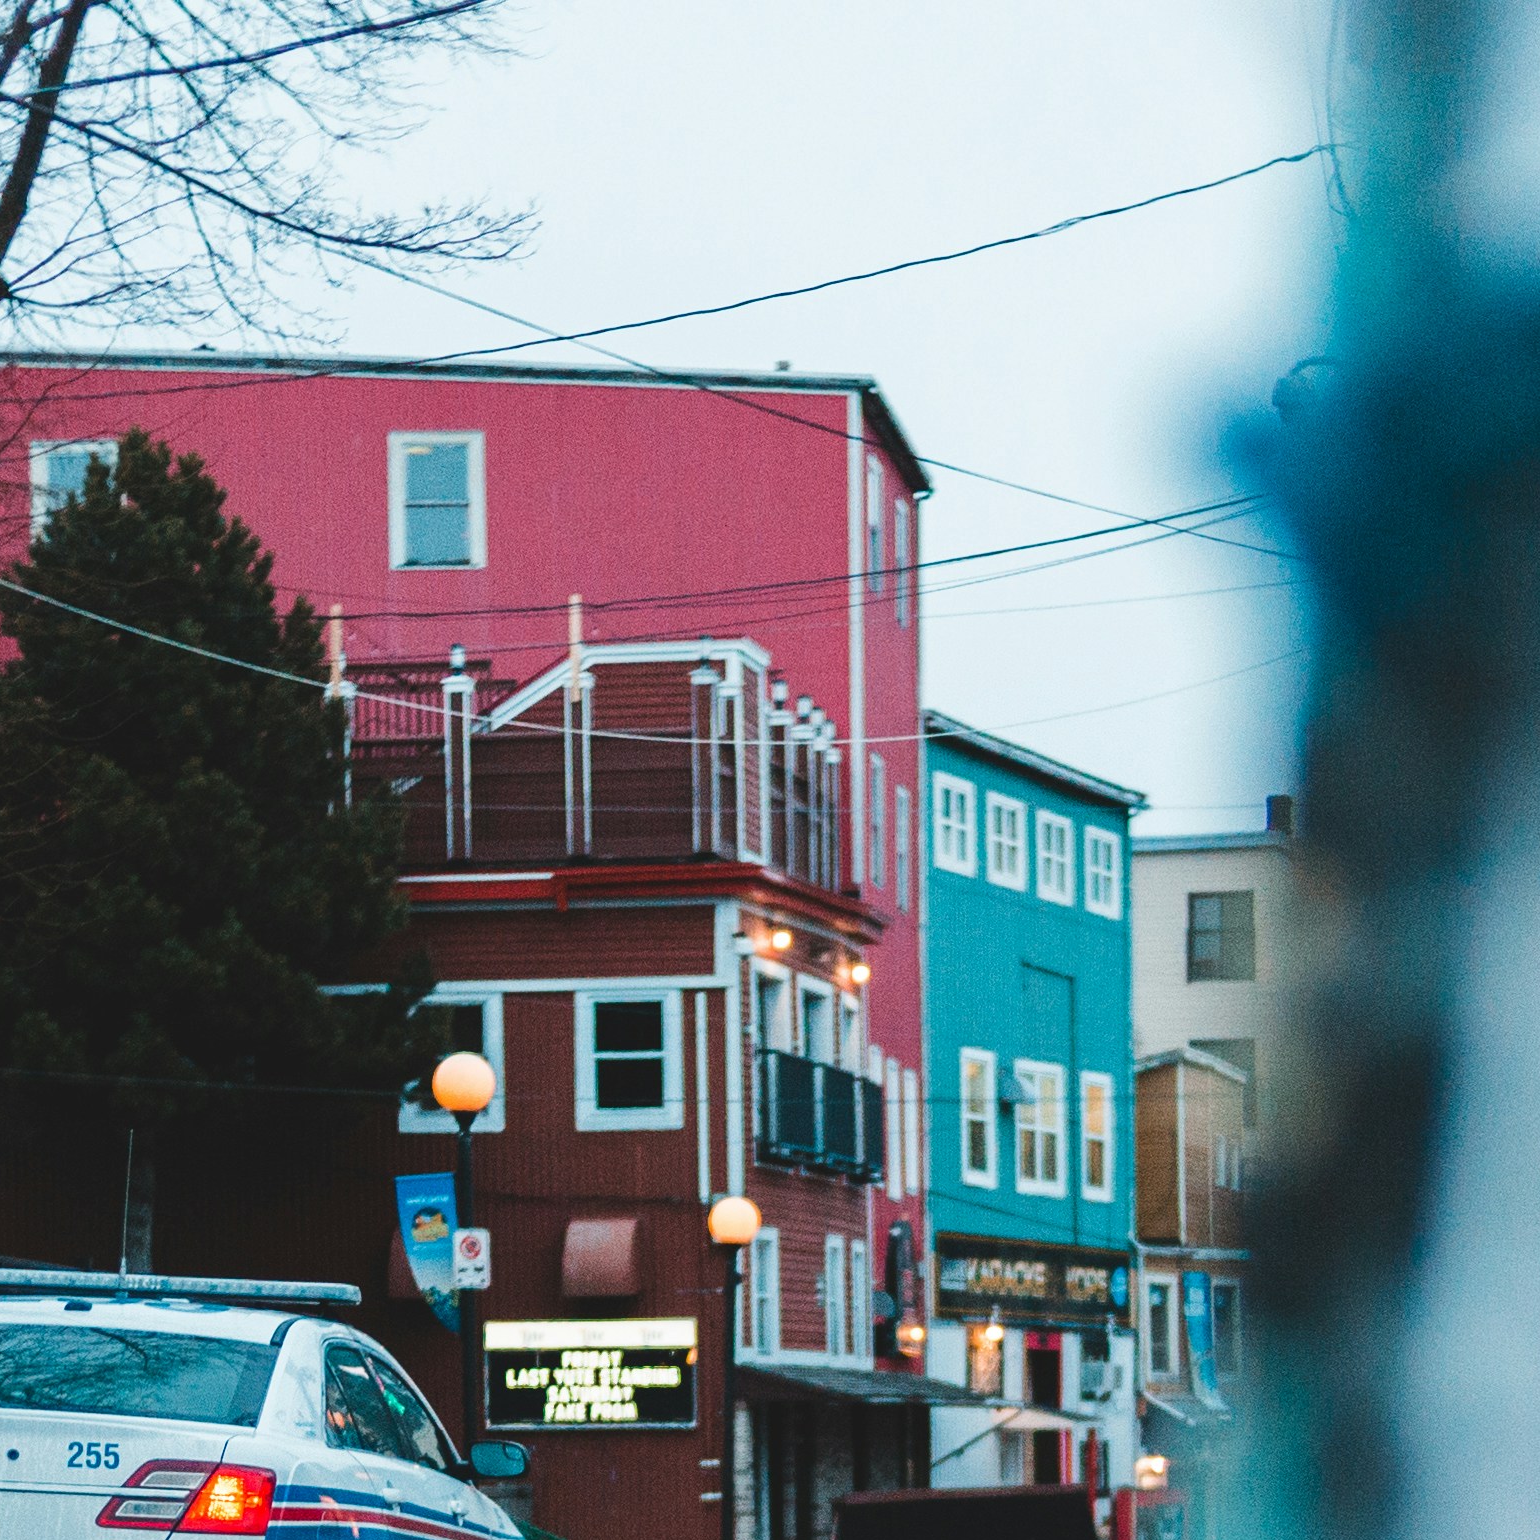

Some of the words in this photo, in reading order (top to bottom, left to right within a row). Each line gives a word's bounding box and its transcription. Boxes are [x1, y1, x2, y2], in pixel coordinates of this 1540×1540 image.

[506, 1368, 550, 1388] LAST
[547, 1386, 634, 1402] SATURDAY
[544, 1403, 587, 1421] FAKE
[67, 1441, 121, 1470] 255
